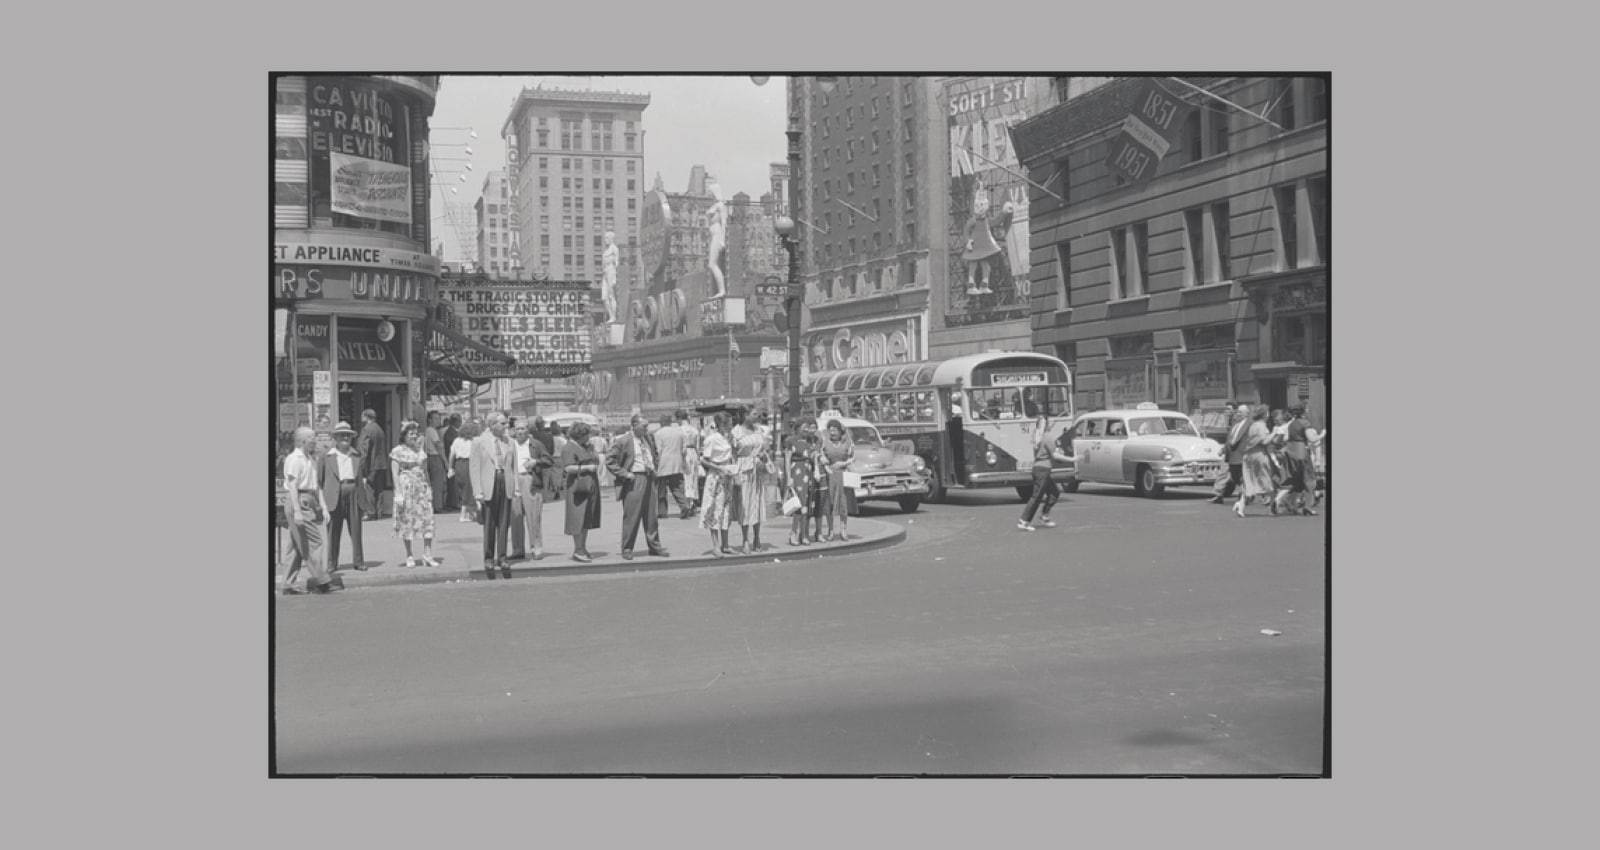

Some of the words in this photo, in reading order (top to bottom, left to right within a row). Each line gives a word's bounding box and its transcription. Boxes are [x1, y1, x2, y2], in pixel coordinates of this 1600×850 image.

[1142, 90, 1176, 130] 1851
[1114, 143, 1150, 179] 1951
[295, 246, 380, 263] APPLIANCE
[450, 291, 474, 302] THE
[476, 291, 524, 302] TRAGIC
[526, 291, 564, 303] STORY
[569, 292, 585, 303] OF
[767, 286, 778, 295] 42
[779, 286, 789, 295] ST
[467, 303, 509, 315] DRUGS
[513, 304, 540, 315] AND
[547, 304, 585, 315] CRIME
[631, 288, 688, 342] BOND
[297, 324, 328, 337] CANDY
[533, 317, 585, 332] SLEEP
[480, 334, 545, 350] SCHOOL
[550, 335, 586, 350] GIRL
[832, 318, 917, 369] Camel
[519, 351, 555, 362] ROAM
[558, 351, 586, 362] CITY
